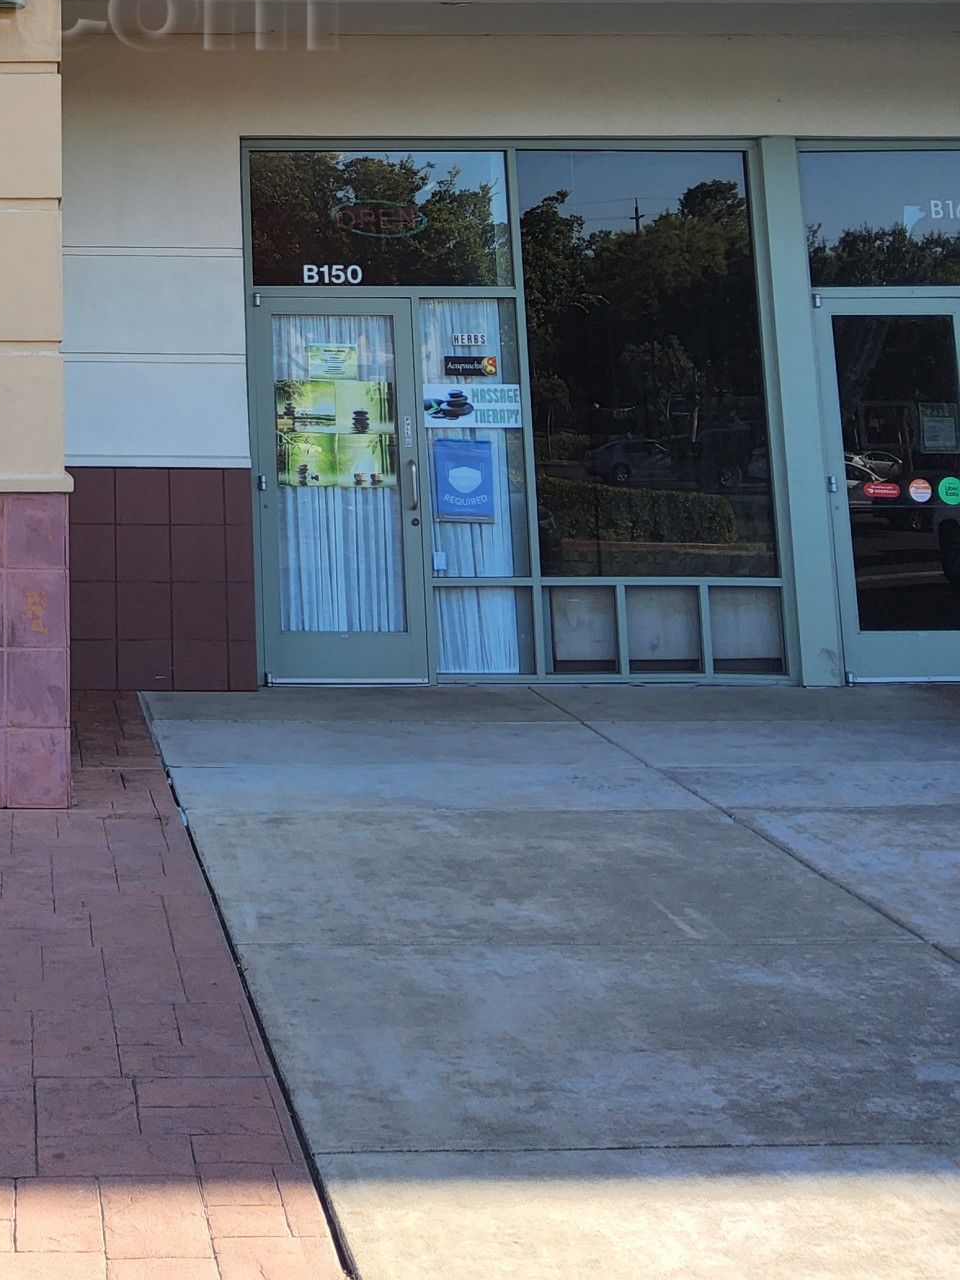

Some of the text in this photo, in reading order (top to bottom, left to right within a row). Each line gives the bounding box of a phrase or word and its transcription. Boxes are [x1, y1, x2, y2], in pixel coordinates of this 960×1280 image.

[930, 199, 960, 219] B1
[335, 207, 417, 230] OPEN
[302, 264, 364, 284] B150
[453, 334, 486, 345] HERBS
[471, 388, 519, 404] MASSAGE
[474, 408, 519, 424] THERAPY
[443, 493, 488, 506] REQUIRED
